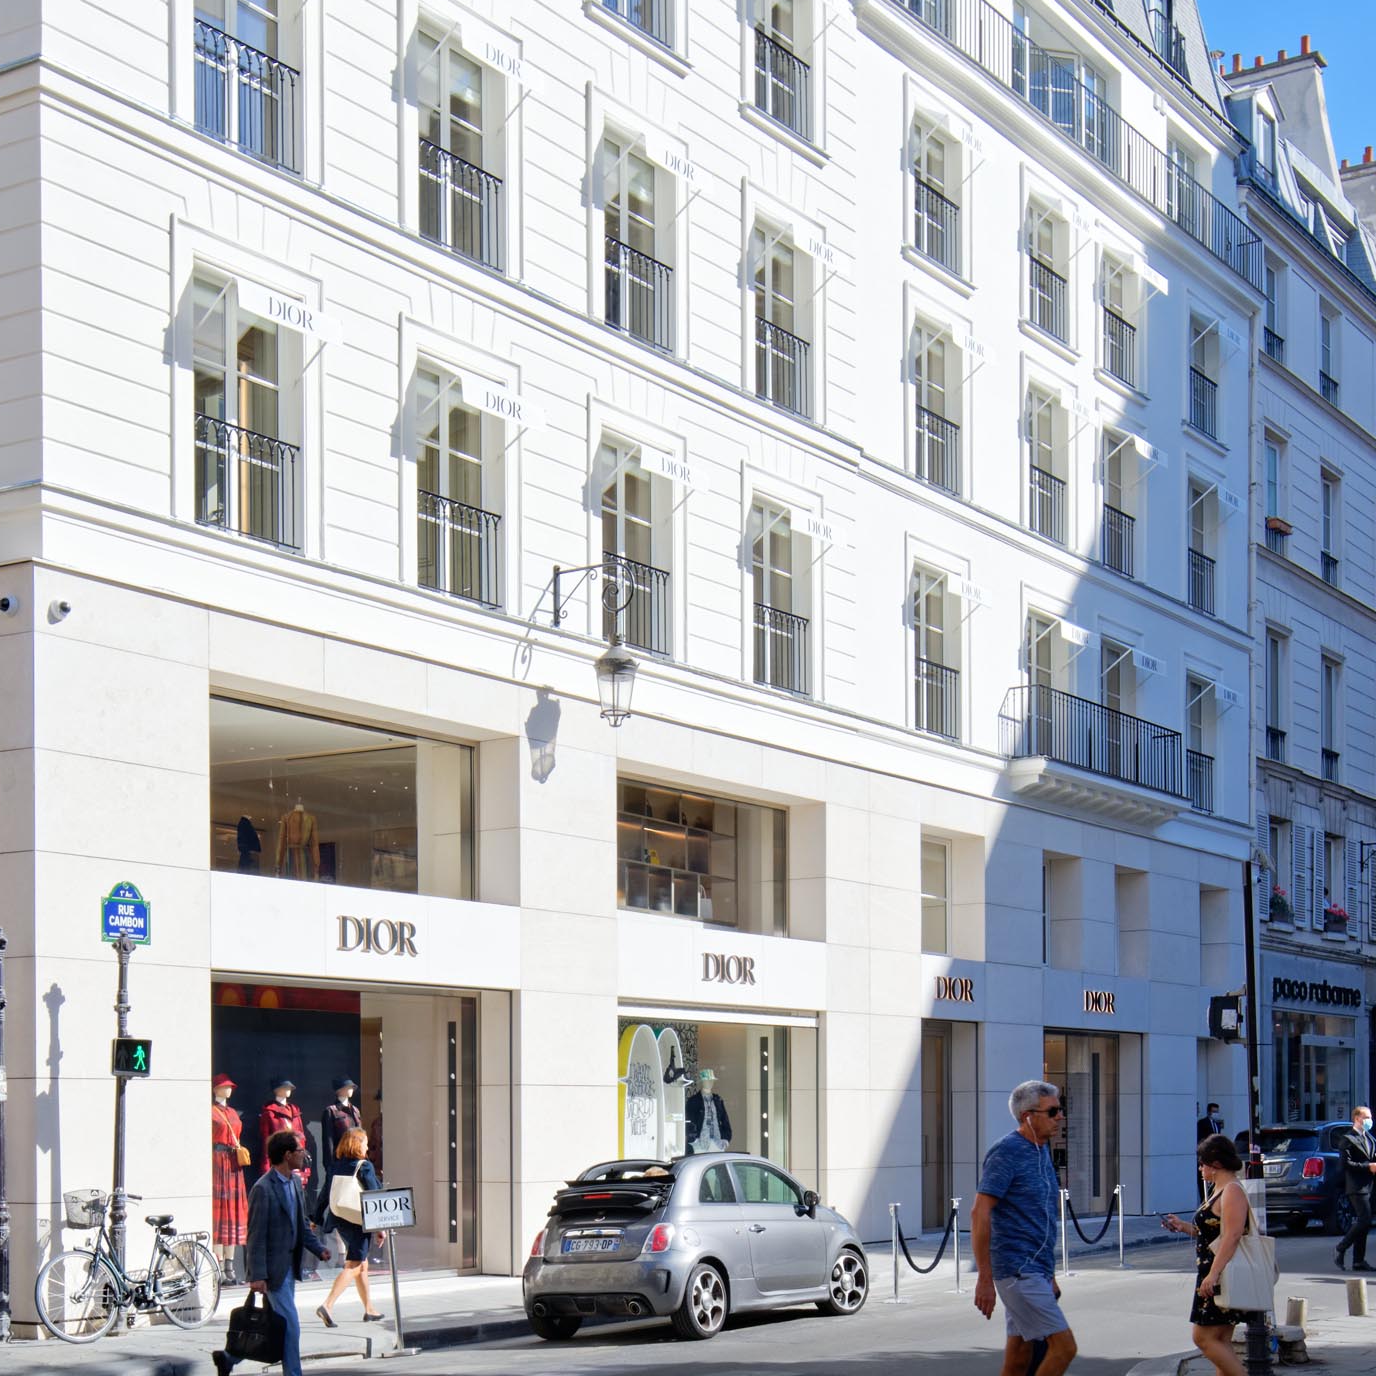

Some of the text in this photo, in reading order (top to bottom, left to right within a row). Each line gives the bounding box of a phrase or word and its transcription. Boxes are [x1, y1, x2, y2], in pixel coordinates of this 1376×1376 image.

[486, 43, 522, 78] DIOR
[665, 150, 695, 180] DIOR
[809, 238, 833, 263] DIOR
[269, 297, 314, 331] DIOR
[965, 336, 984, 357] DIOR
[485, 391, 521, 421] DIOR
[661, 458, 690, 483] DIOR
[807, 518, 832, 540] DIOR
[962, 582, 981, 600] DIOR
[1142, 656, 1157, 671] DIOR
[109, 915, 144, 929] CAMBON
[118, 904, 135, 916] RUE
[337, 915, 418, 957] DIOR
[701, 952, 755, 985] DIOR
[936, 976, 974, 1003] DIOR
[1273, 977, 1361, 1007] paco rabanne
[1083, 990, 1115, 1015] DIOR
[365, 1197, 411, 1214] DIOR
